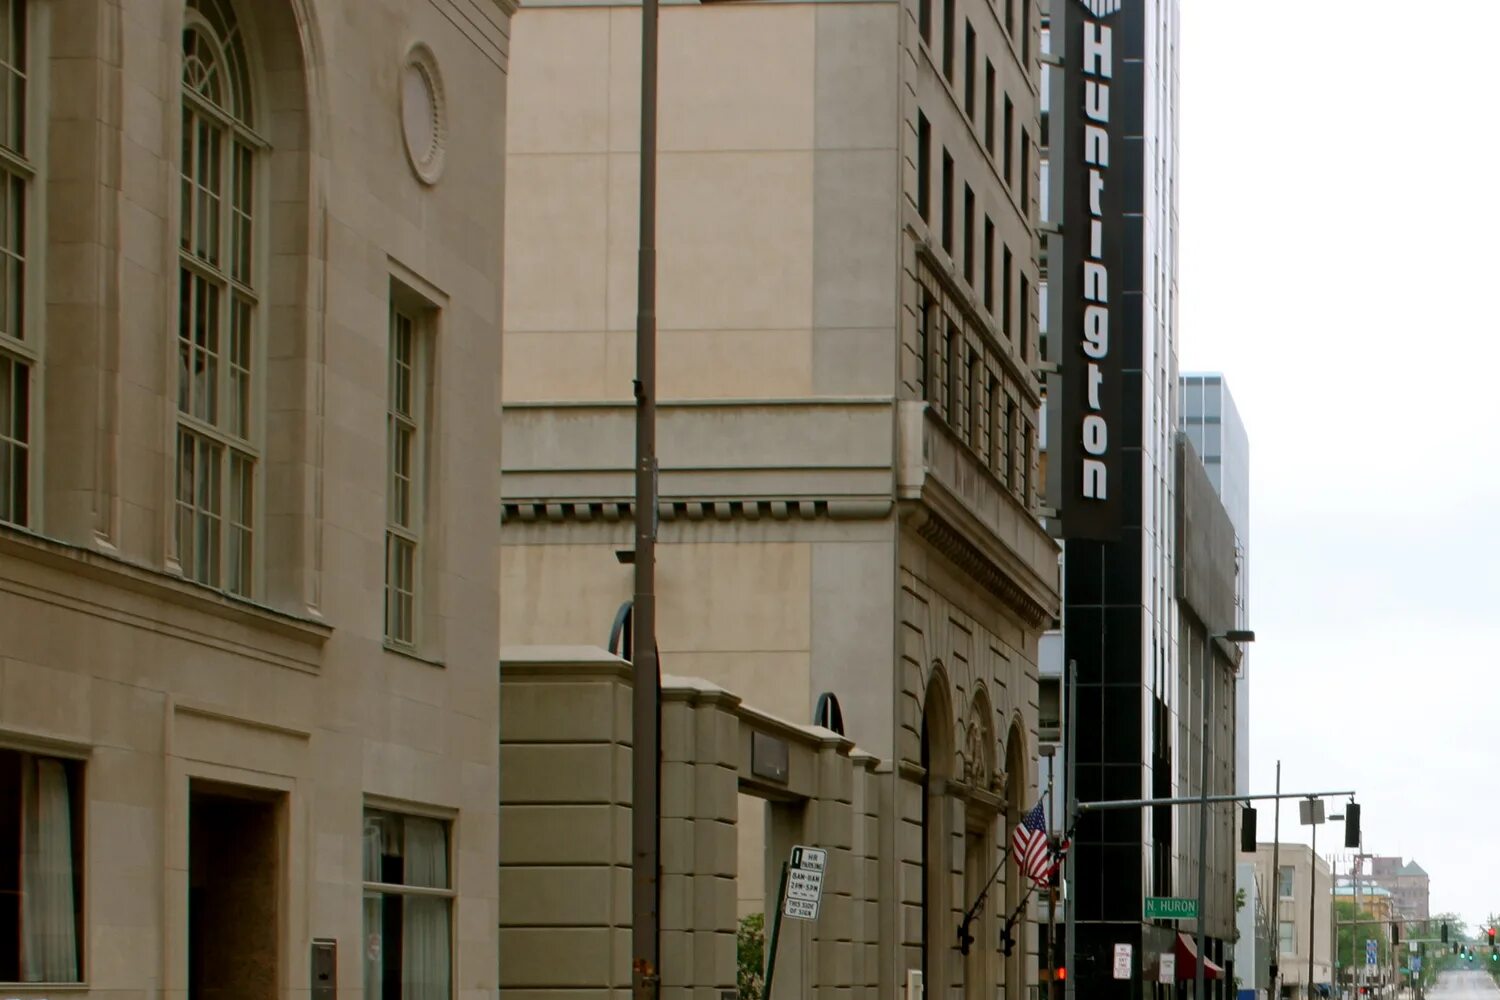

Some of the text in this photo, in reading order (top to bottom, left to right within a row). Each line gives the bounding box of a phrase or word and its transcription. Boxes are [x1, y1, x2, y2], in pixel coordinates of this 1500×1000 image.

[1082, 20, 1113, 500] Huntington
[1147, 901, 1195, 912] N. HURON
